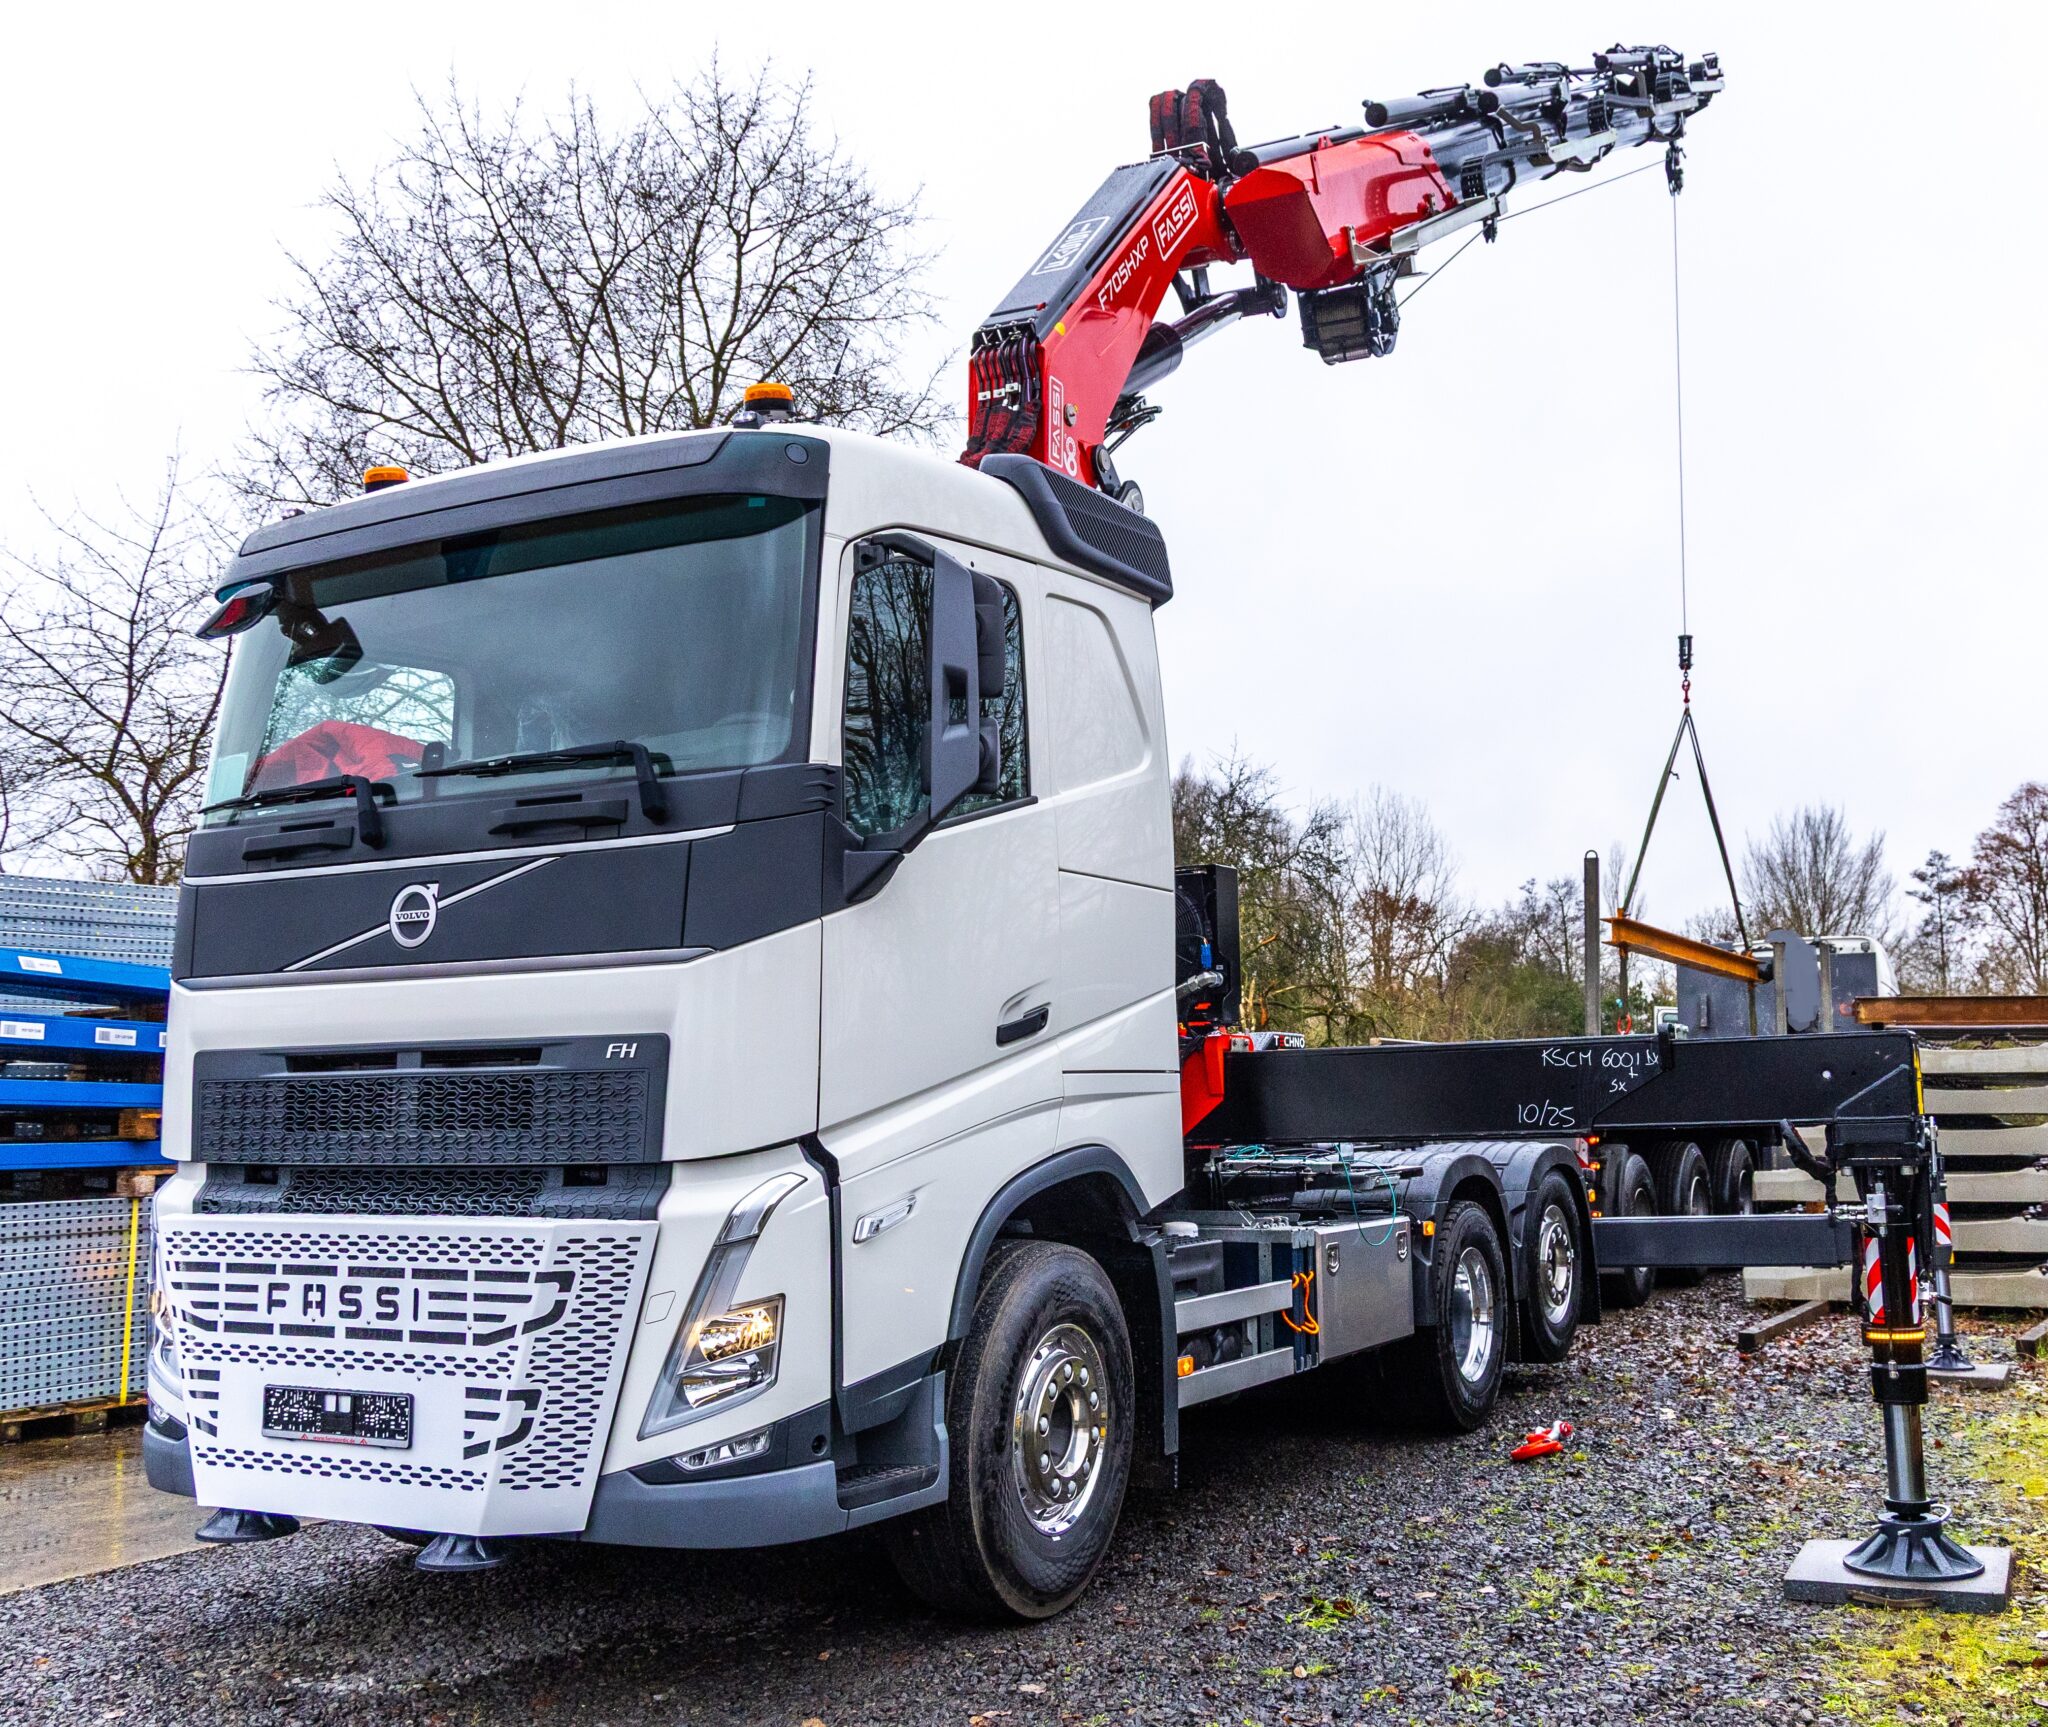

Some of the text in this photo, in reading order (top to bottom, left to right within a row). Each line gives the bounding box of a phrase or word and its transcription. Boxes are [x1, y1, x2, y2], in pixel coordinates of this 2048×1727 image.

[1157, 191, 1195, 248] FASSI
[1097, 235, 1149, 312] F705HXP
[1052, 384, 1061, 460] FASSI
[395, 911, 430, 921] VOLVO
[605, 1042, 638, 1059] FH
[1273, 1035, 1306, 1049] TECHNO
[1541, 1047, 1592, 1068] KSCM
[1518, 1099, 1576, 1128] 10/25
[266, 1282, 420, 1322] FASSI
